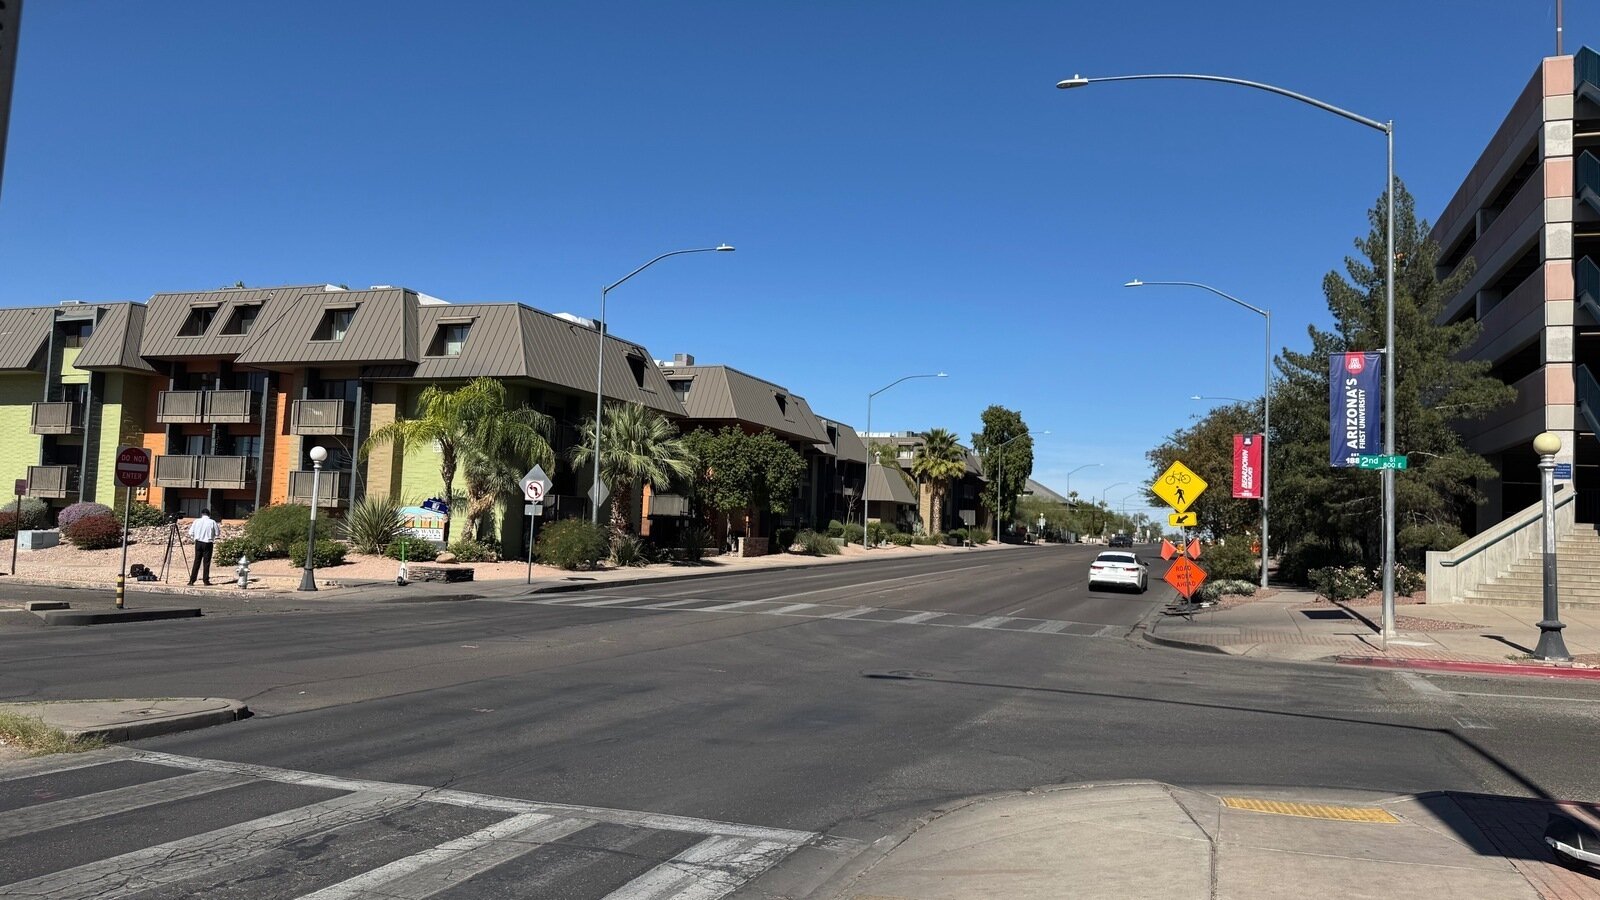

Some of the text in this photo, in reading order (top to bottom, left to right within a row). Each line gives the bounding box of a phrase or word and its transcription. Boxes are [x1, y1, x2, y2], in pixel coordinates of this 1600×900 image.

[1345, 378, 1358, 449] ARIZONA'S
[1358, 389, 1366, 449] FIRST UNIVERSITY
[133, 455, 146, 463] NOT
[1360, 456, 1379, 467] 2nd
[122, 472, 142, 480] ENTER
